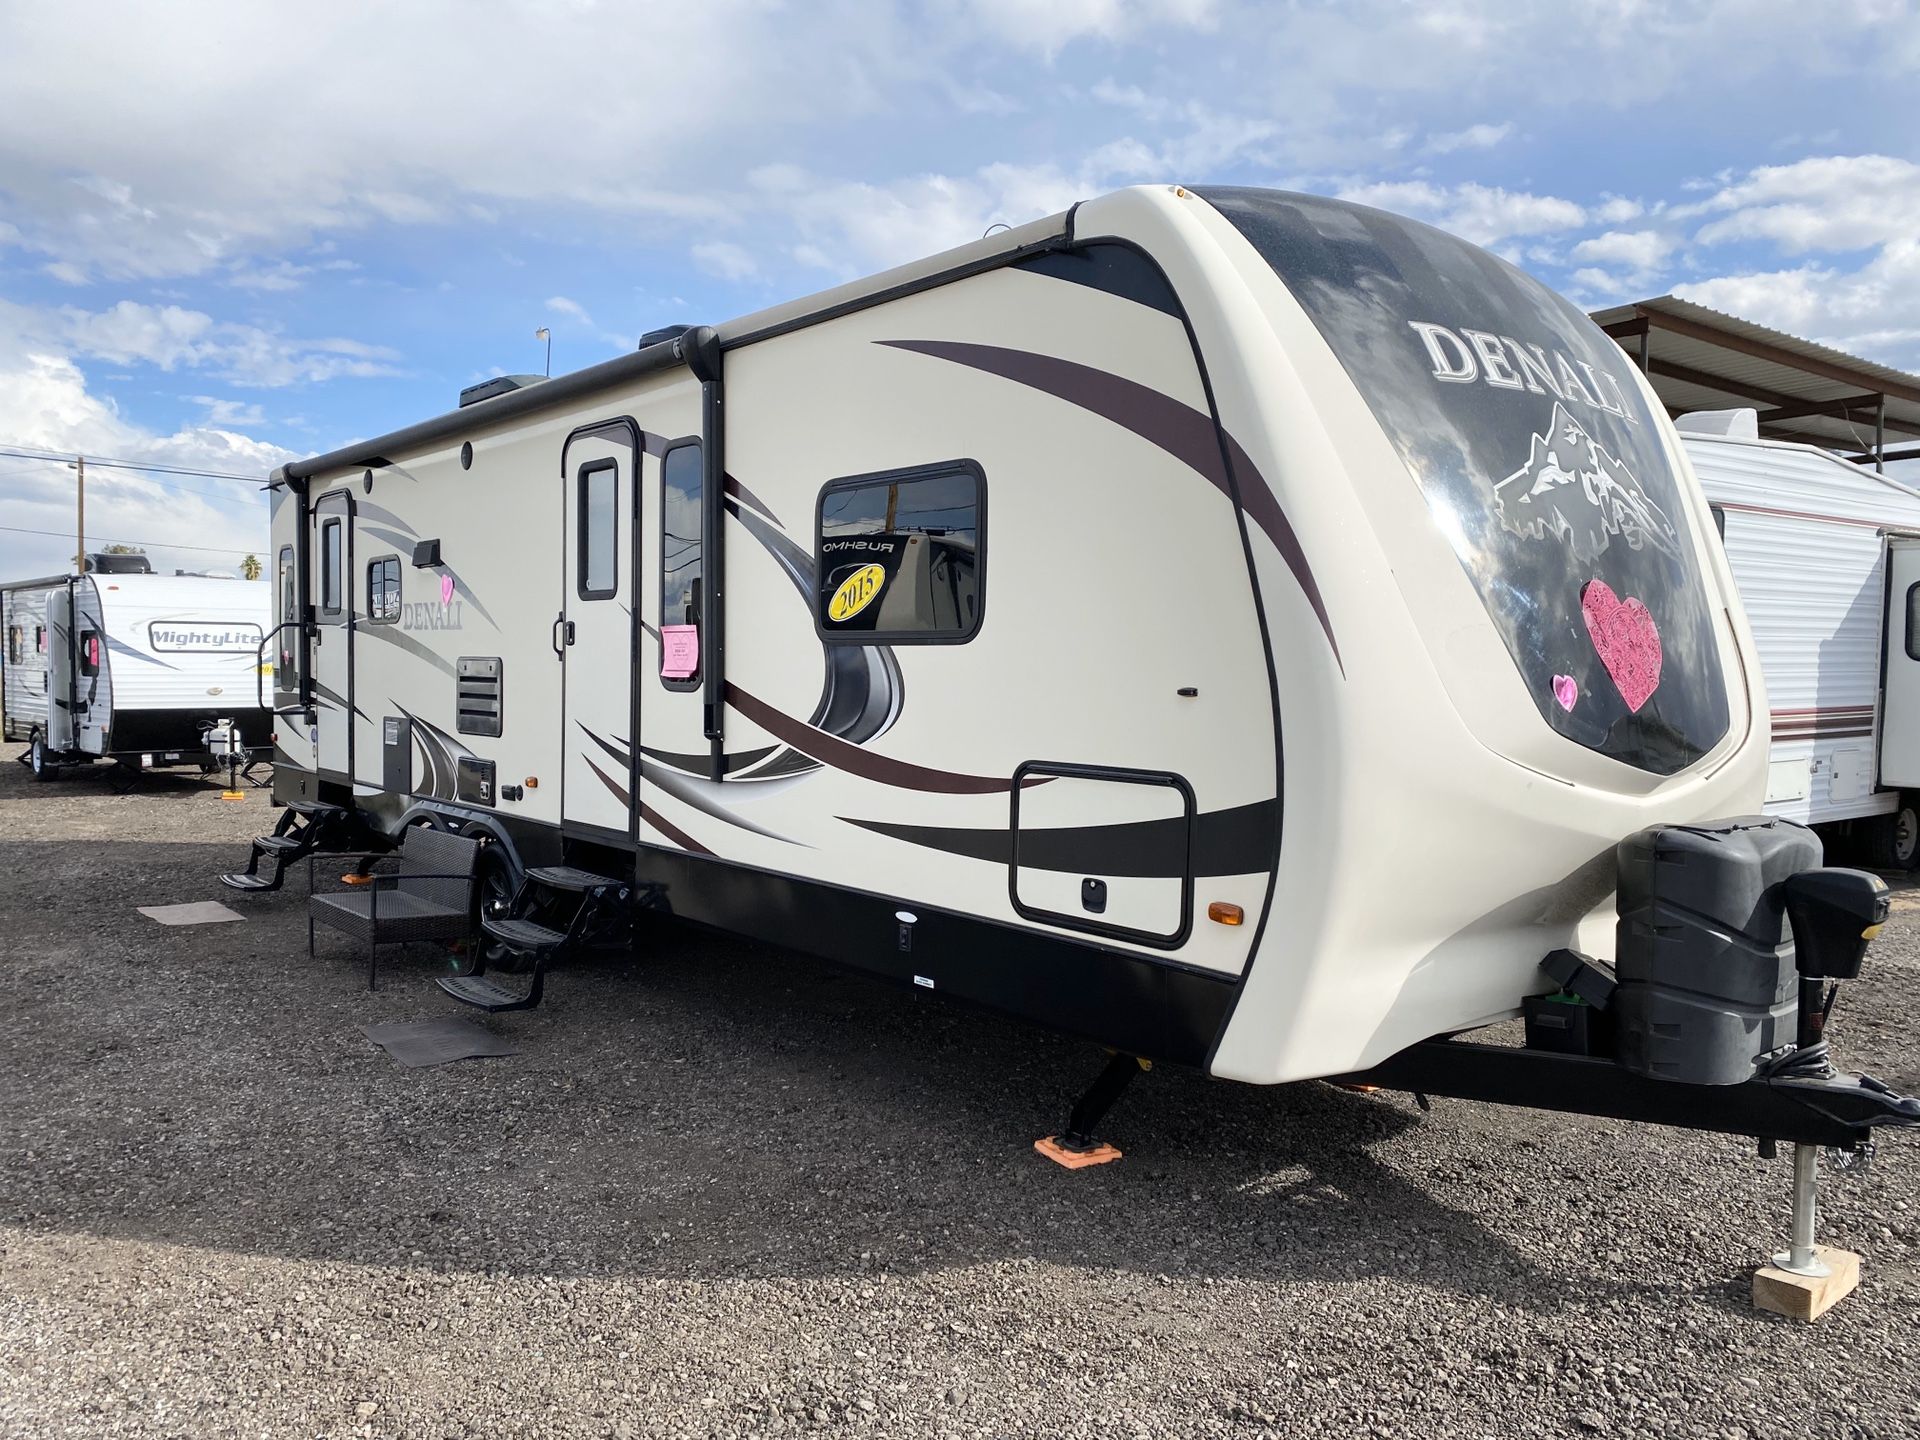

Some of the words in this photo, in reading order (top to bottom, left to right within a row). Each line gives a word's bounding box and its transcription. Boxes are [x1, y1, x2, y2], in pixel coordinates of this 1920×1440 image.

[1408, 320, 1639, 424] DENALI
[840, 568, 874, 617] 2015
[403, 601, 463, 630] DENALI
[153, 631, 263, 646] MightyLite
